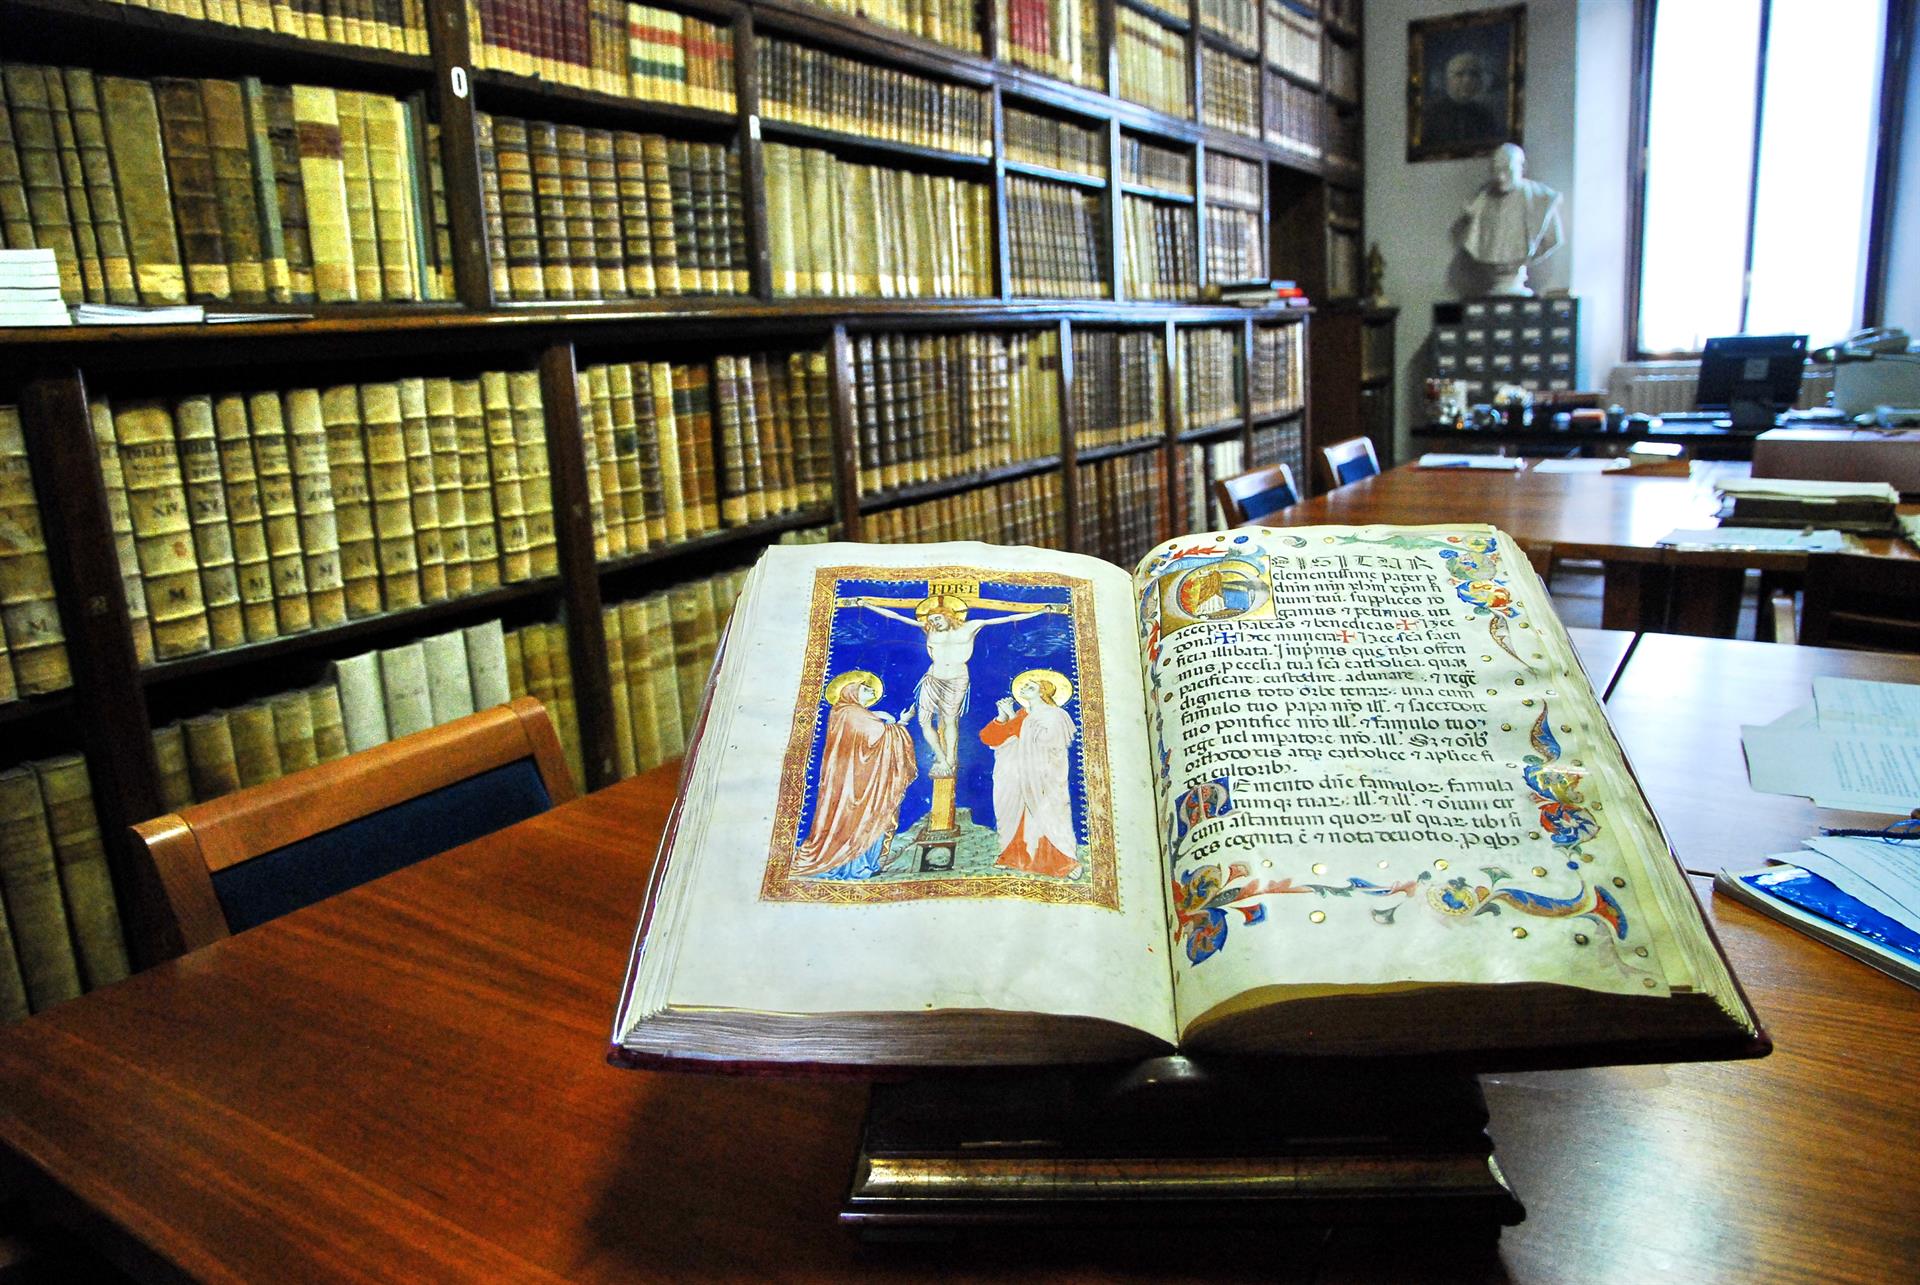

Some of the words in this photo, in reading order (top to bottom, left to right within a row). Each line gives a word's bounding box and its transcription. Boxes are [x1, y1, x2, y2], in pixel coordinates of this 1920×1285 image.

[1257, 688, 1294, 697] toto
[1181, 701, 1240, 726] famulo
[1247, 702, 1278, 712] tuo
[1285, 701, 1327, 716] papa
[1182, 722, 1211, 741] tuo
[1375, 714, 1439, 730] famulo
[1191, 817, 1225, 844] cum
